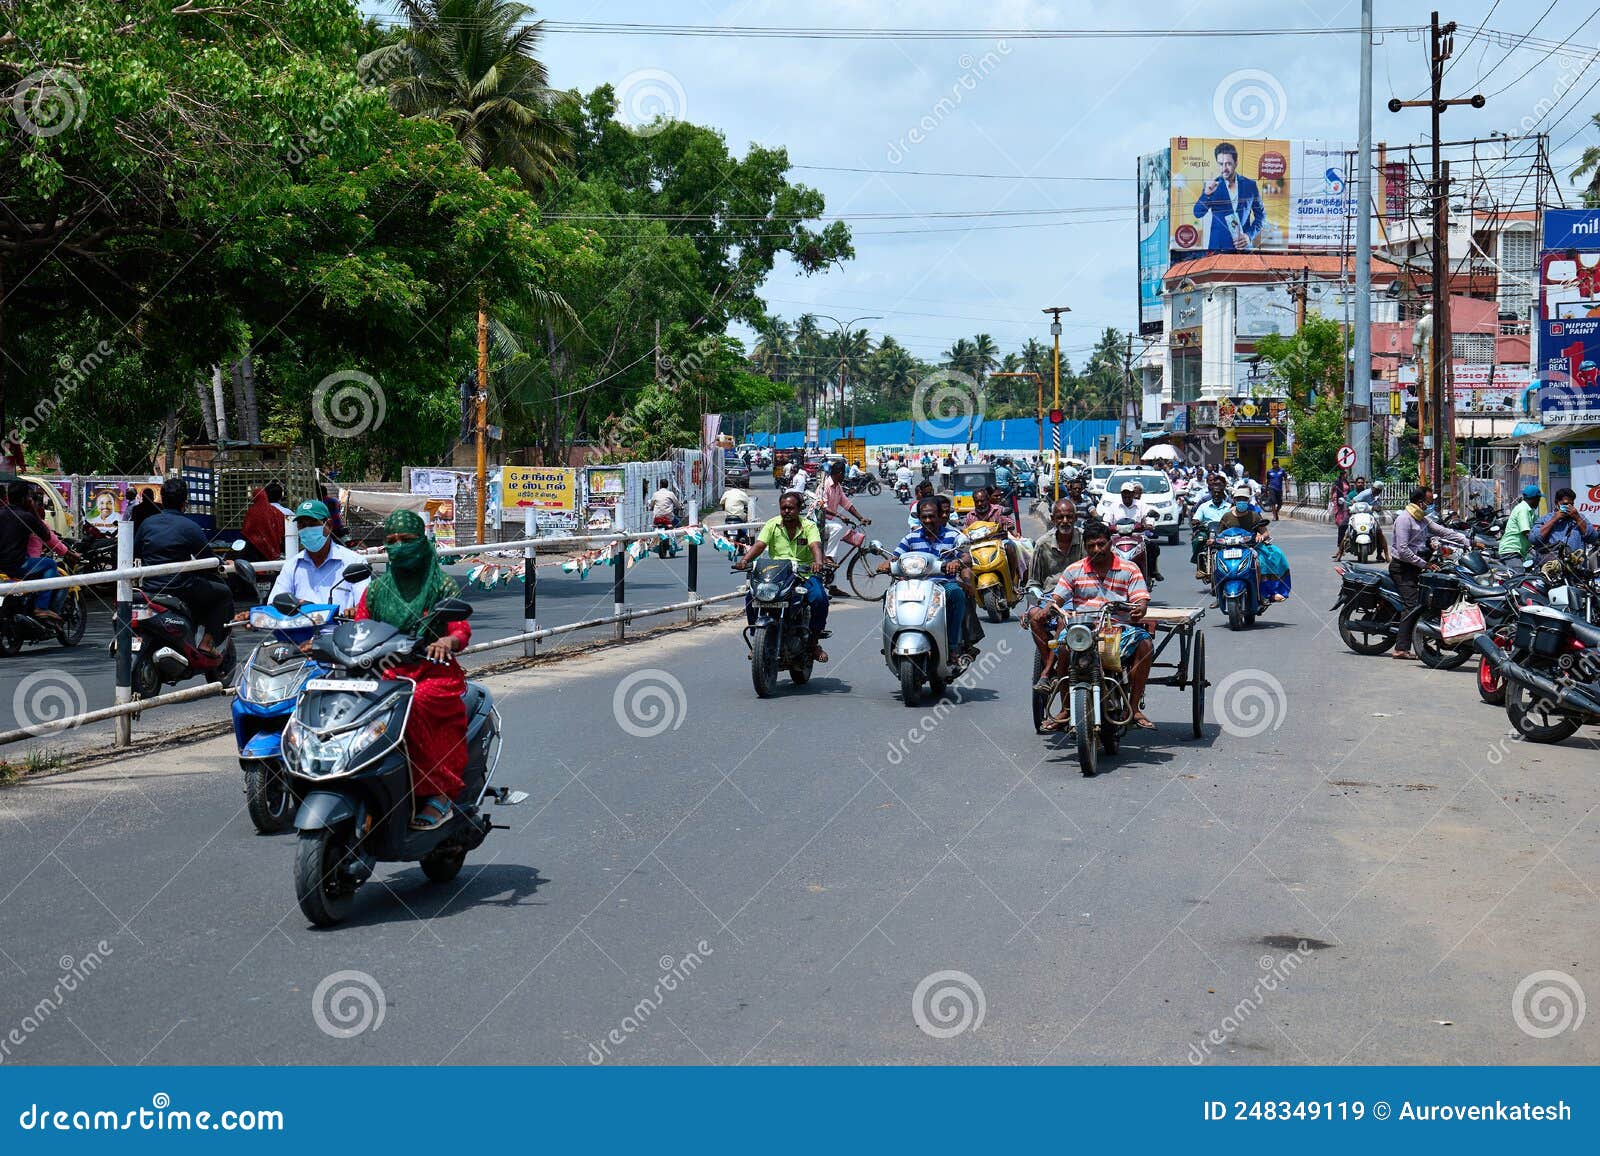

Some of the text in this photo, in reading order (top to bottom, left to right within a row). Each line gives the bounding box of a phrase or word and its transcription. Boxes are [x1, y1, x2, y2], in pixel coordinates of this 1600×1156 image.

[1297, 207, 1358, 215] SUDHA HOSPTA
[1569, 327, 1595, 335] PAINT
[1548, 363, 1568, 371] REAL
[1549, 413, 1567, 422] Shri
